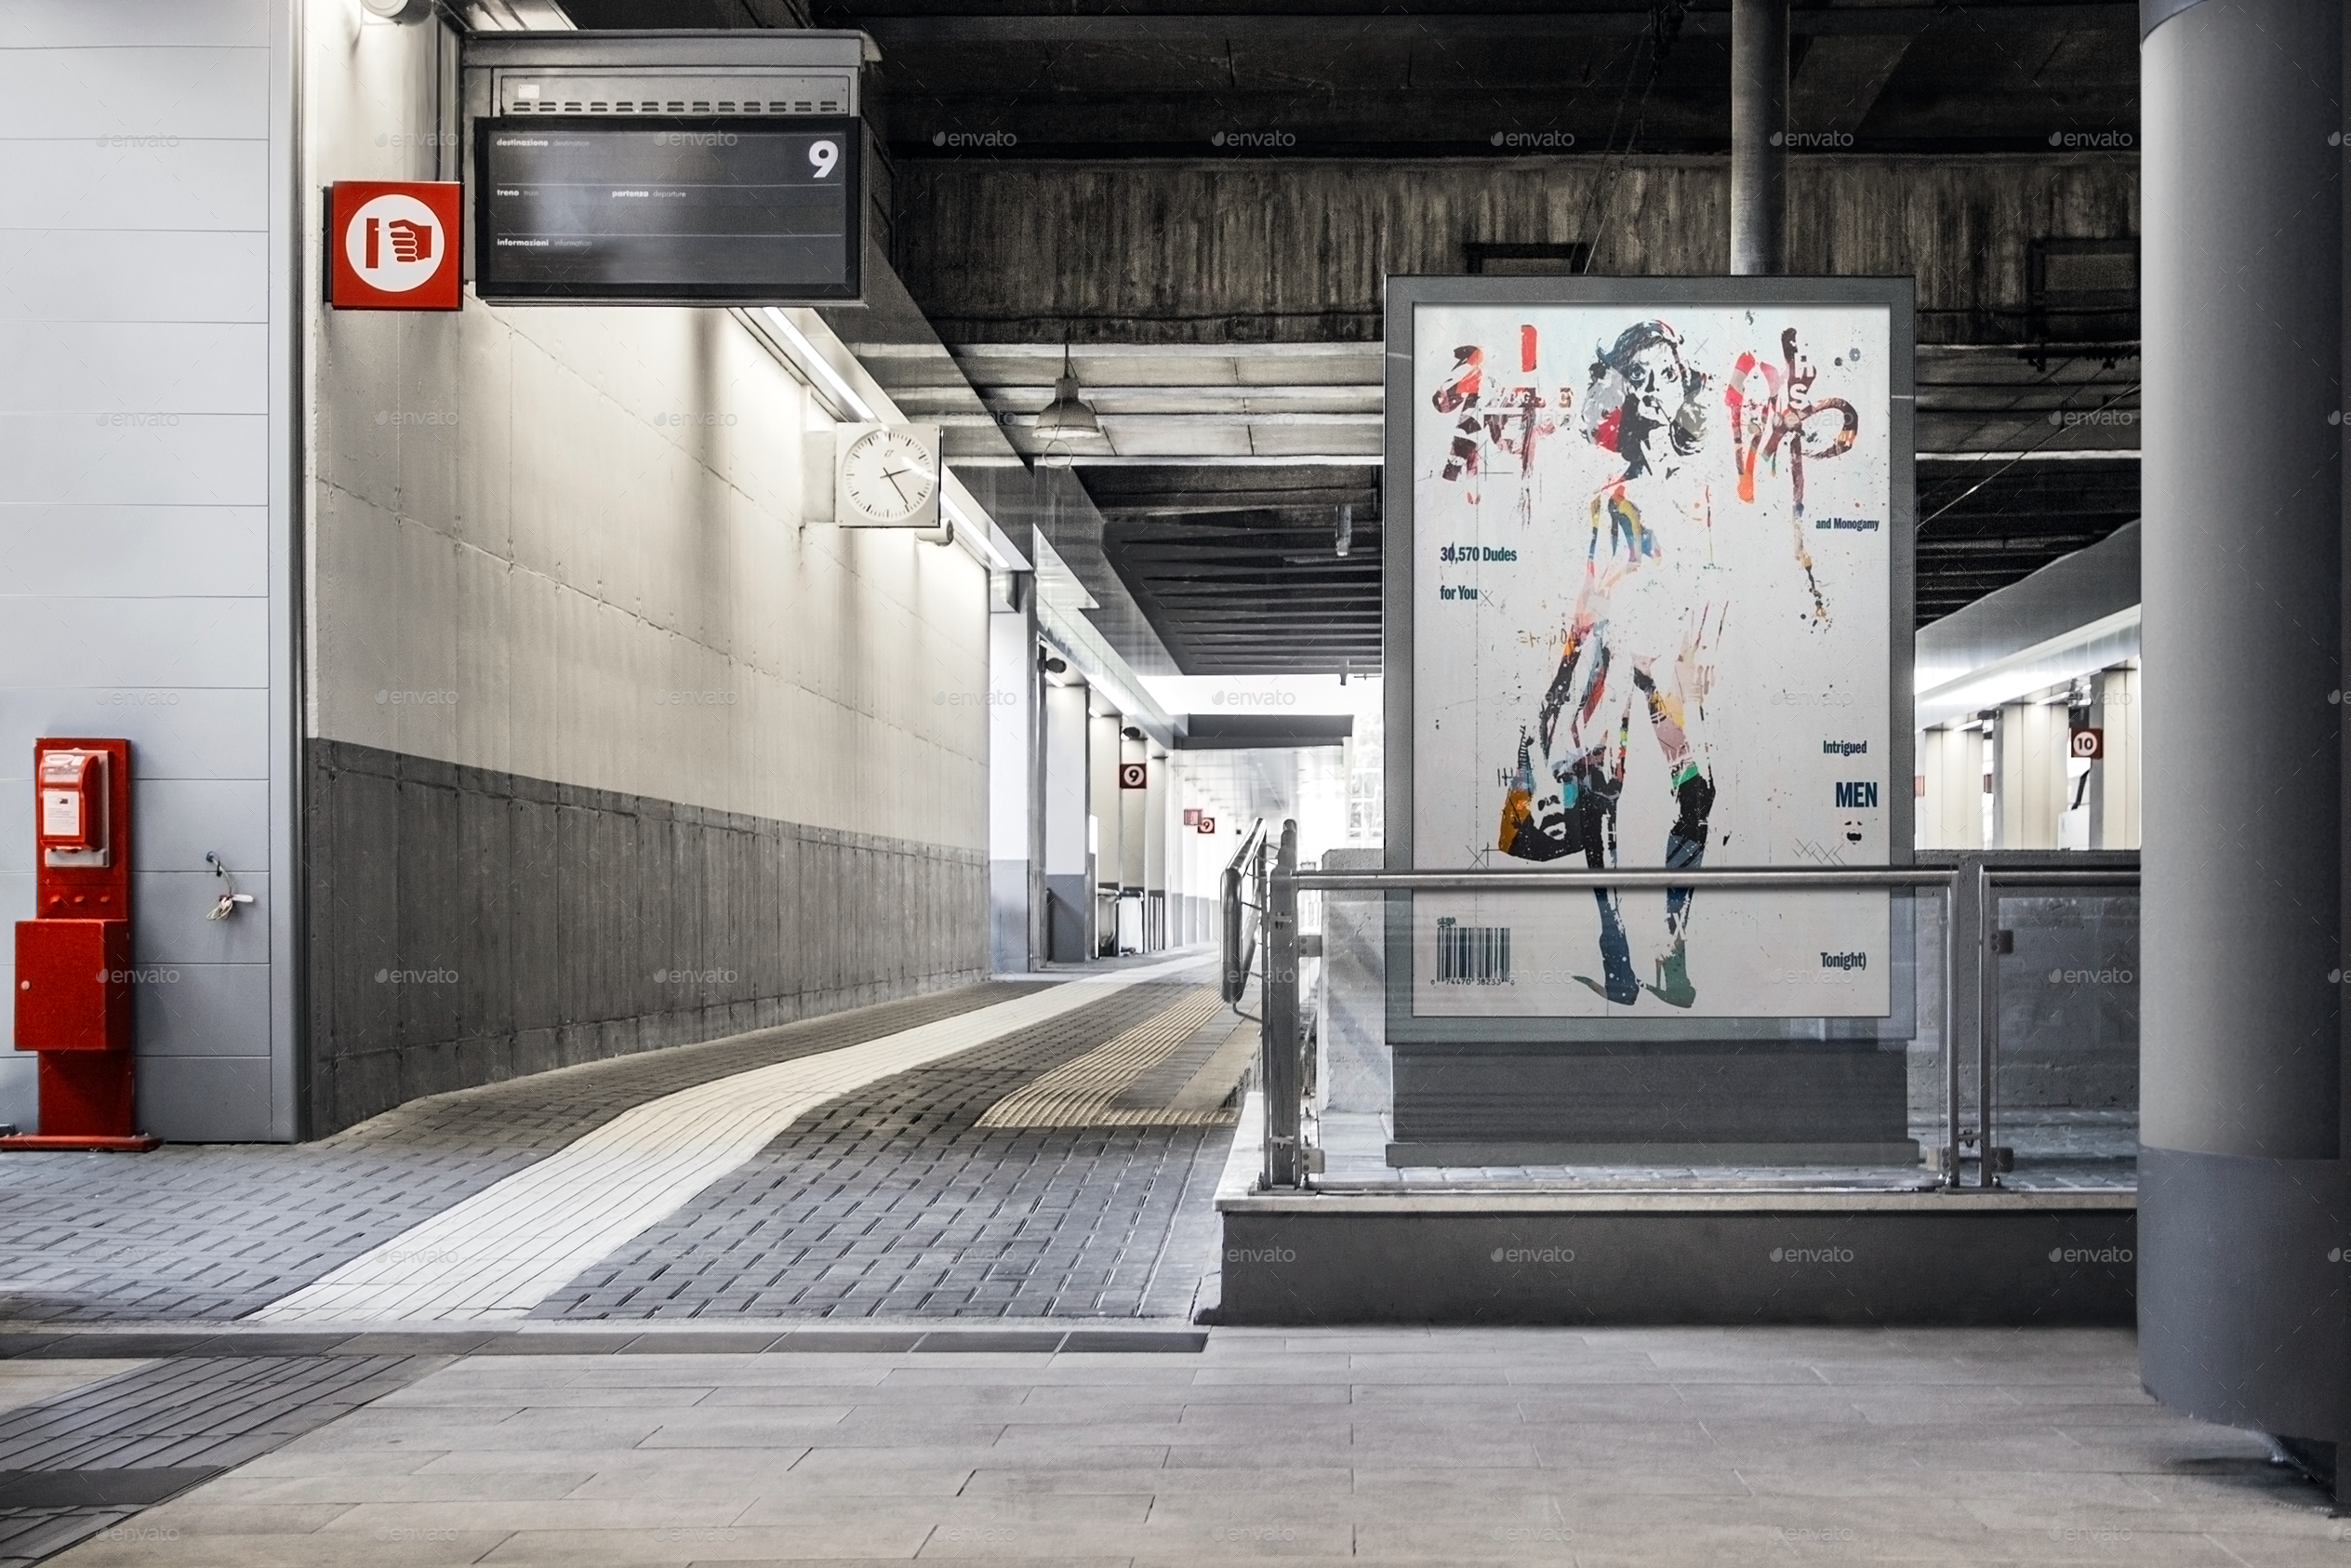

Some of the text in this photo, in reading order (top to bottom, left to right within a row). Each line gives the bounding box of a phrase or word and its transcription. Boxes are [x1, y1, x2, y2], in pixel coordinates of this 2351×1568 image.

[497, 138, 591, 148] destinazione destination
[808, 140, 839, 179] 9
[497, 189, 539, 197] treno train
[612, 190, 686, 199] partenza departure
[497, 238, 592, 247] informazioni information
[1815, 517, 1879, 532] and Monogamy
[1440, 546, 1518, 565] 30,570 Dudes
[1440, 585, 1478, 600] for You
[1823, 740, 1867, 757] Intrigued
[2077, 737, 2093, 751] 10
[1128, 768, 1140, 783] 9
[1835, 781, 1878, 808] MEN
[1202, 820, 1211, 831] 9
[1820, 951, 1866, 971] Tonight)
